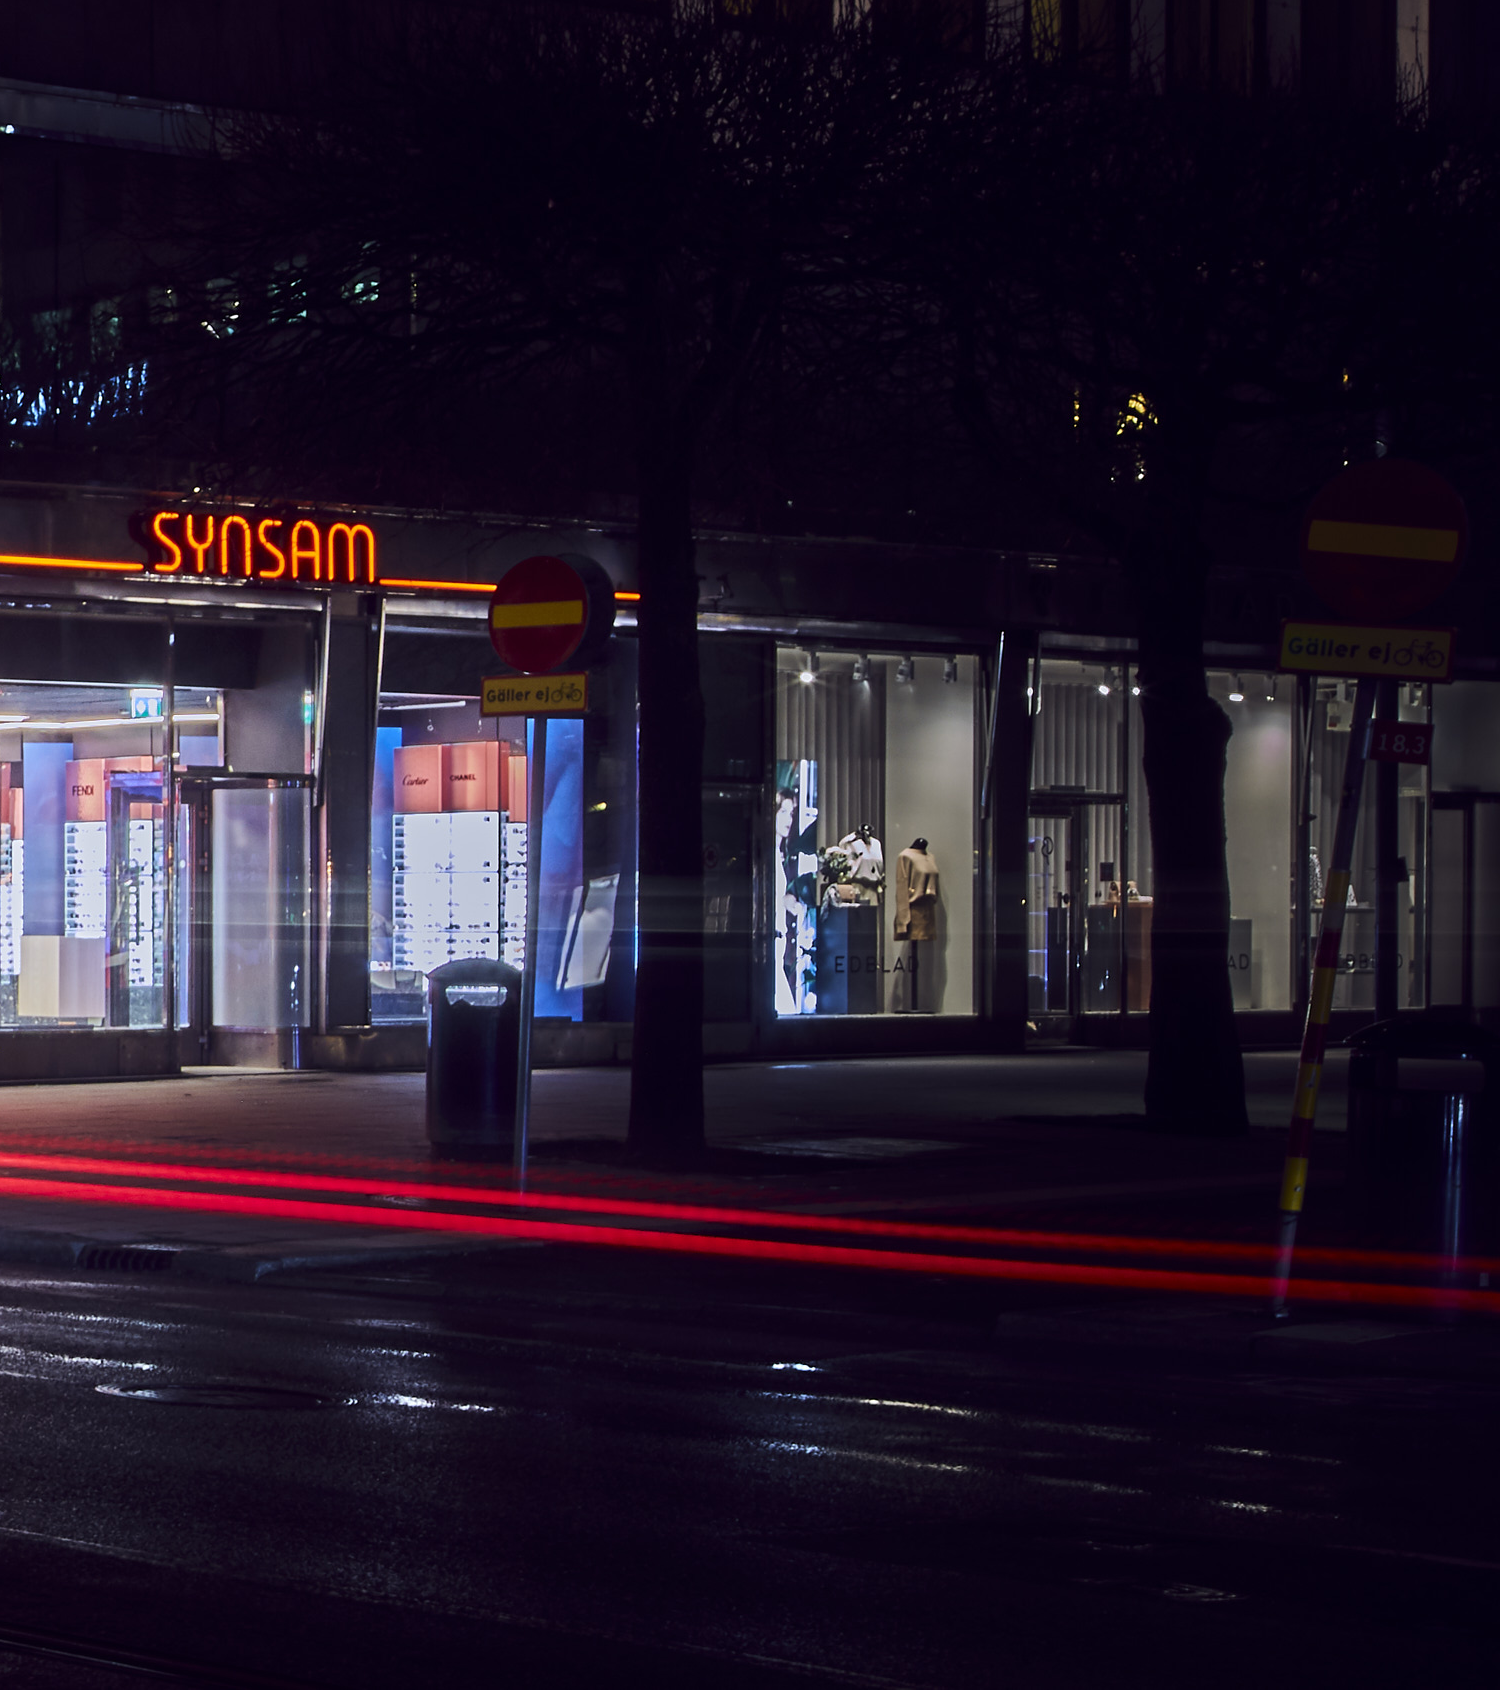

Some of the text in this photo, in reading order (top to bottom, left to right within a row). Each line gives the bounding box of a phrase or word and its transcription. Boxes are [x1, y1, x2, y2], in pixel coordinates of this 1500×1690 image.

[152, 511, 376, 584] SYNSAM
[1287, 636, 1392, 664] Gäller ej
[486, 686, 550, 703] Gäller ej
[1377, 733, 1426, 755] 18,3
[402, 775, 428, 786] Cartier
[449, 774, 476, 782] CHANEL
[72, 785, 94, 796] FENDI
[835, 955, 918, 973] EDBLAD
